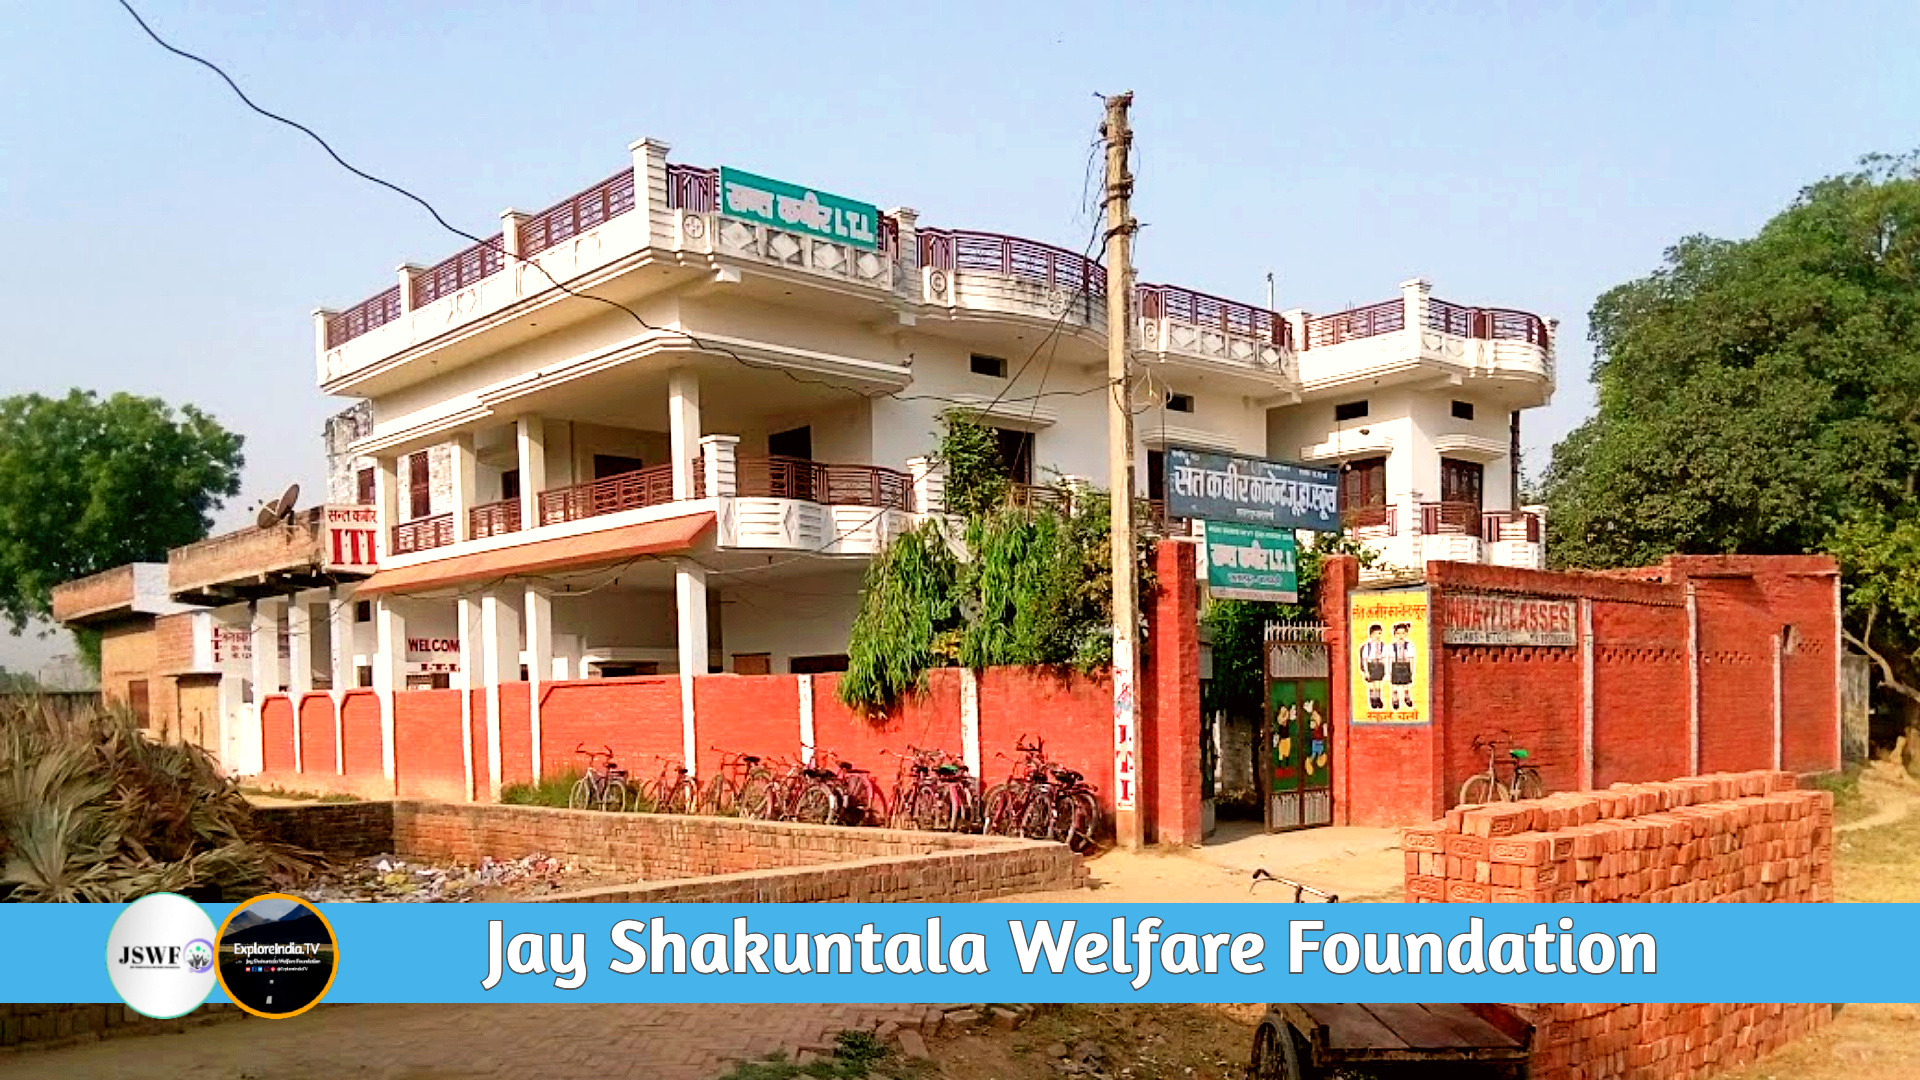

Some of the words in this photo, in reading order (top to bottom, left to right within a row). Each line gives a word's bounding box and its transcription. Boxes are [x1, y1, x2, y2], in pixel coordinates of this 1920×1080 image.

[1173, 458, 1206, 498] संत
[1207, 462, 1249, 504] कबीर
[408, 638, 461, 652] WELCOM
